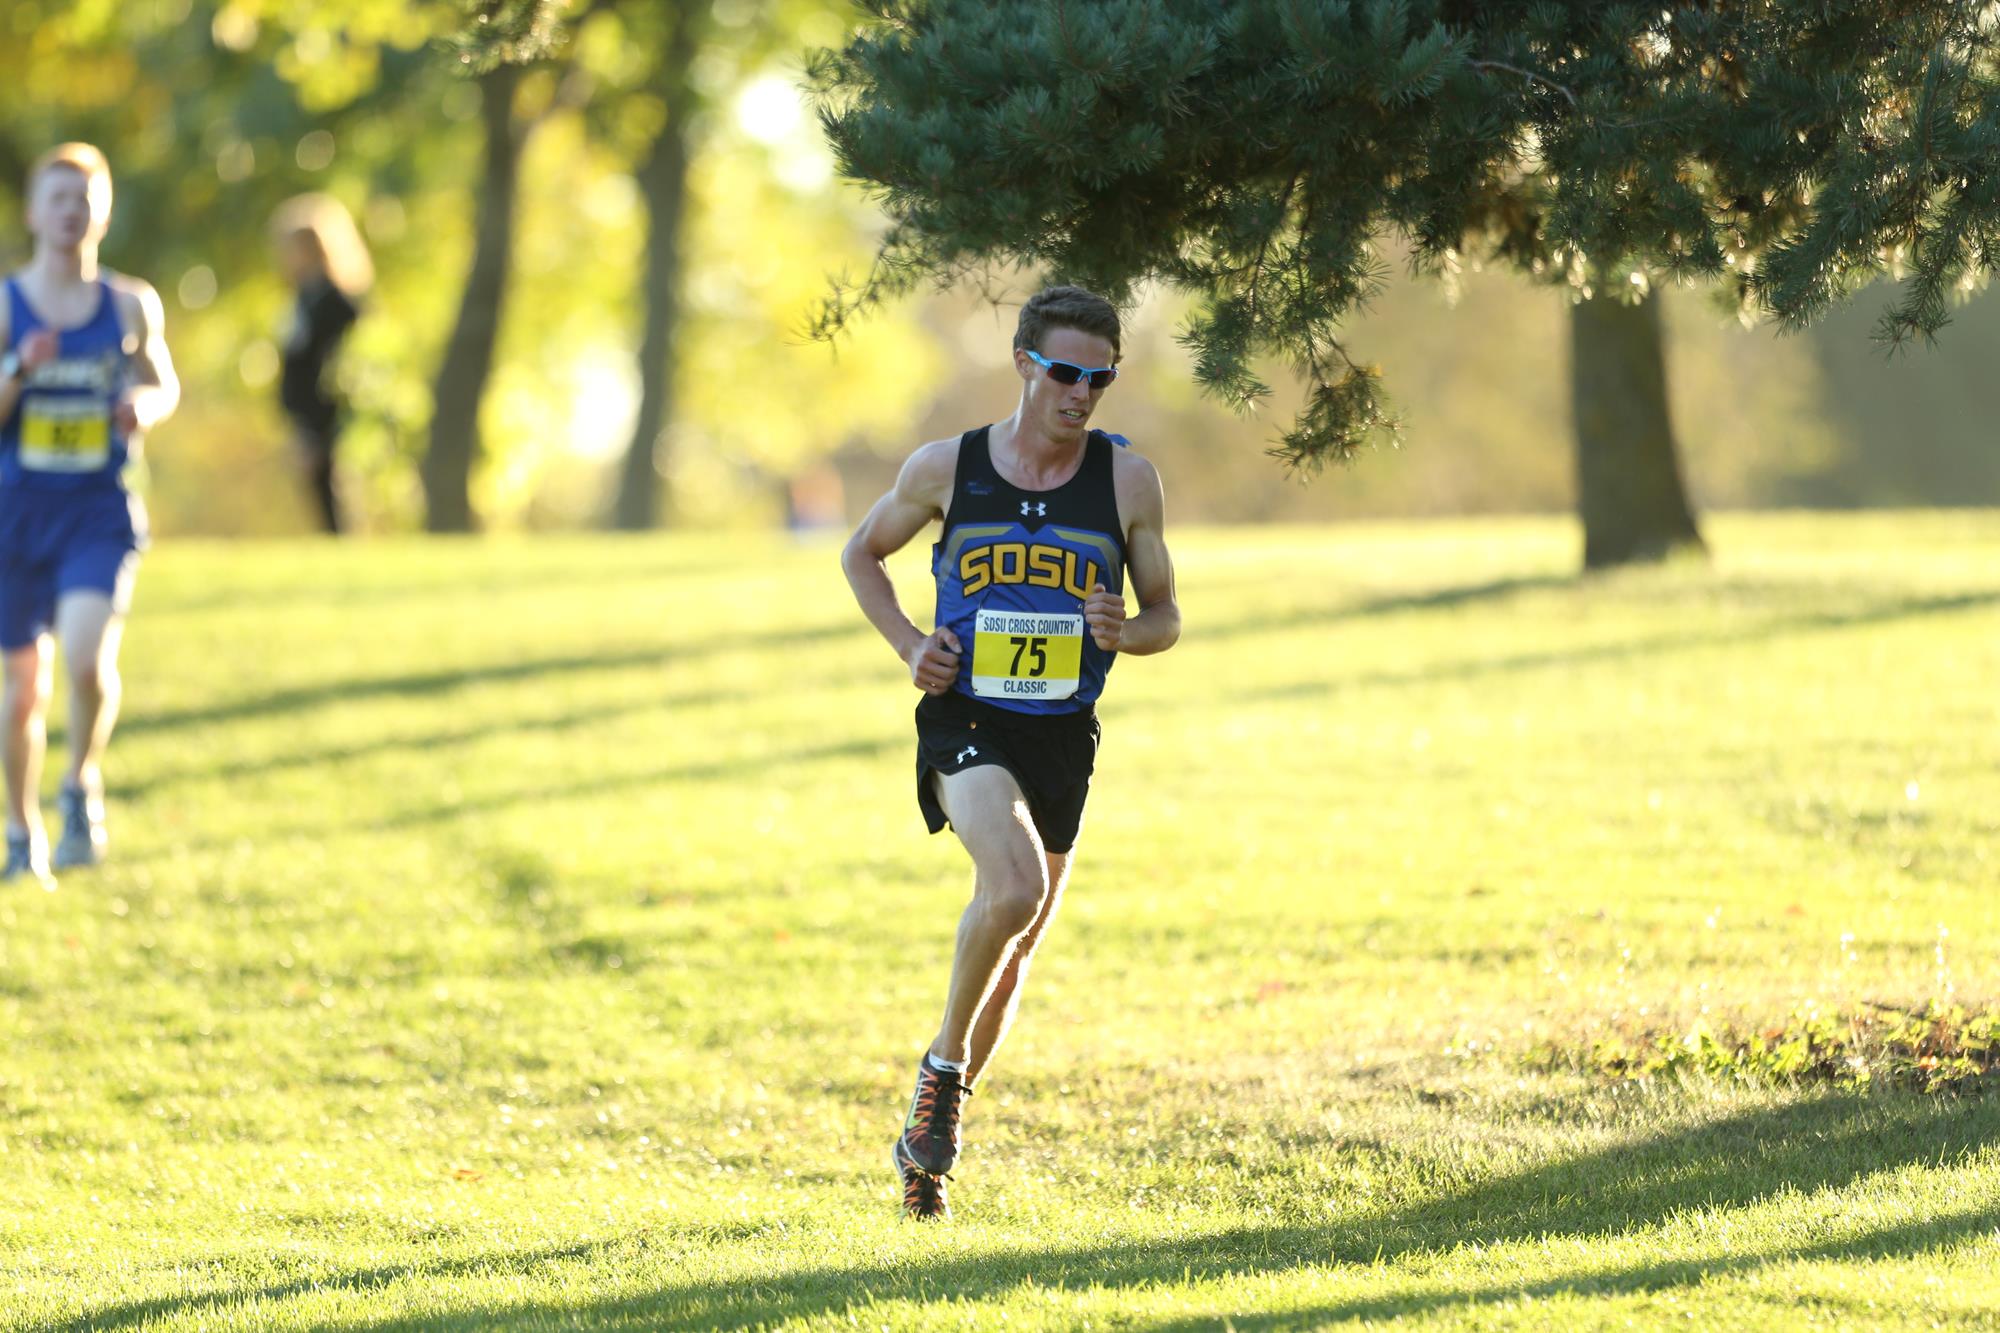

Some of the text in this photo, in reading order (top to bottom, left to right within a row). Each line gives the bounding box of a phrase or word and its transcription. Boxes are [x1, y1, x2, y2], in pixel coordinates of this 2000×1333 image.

[960, 543, 1098, 601] SDSU
[984, 616, 1075, 635] SDSU CROSS COUNTRY
[1010, 637, 1048, 677] 75
[1004, 680, 1047, 694] CLASSIC
